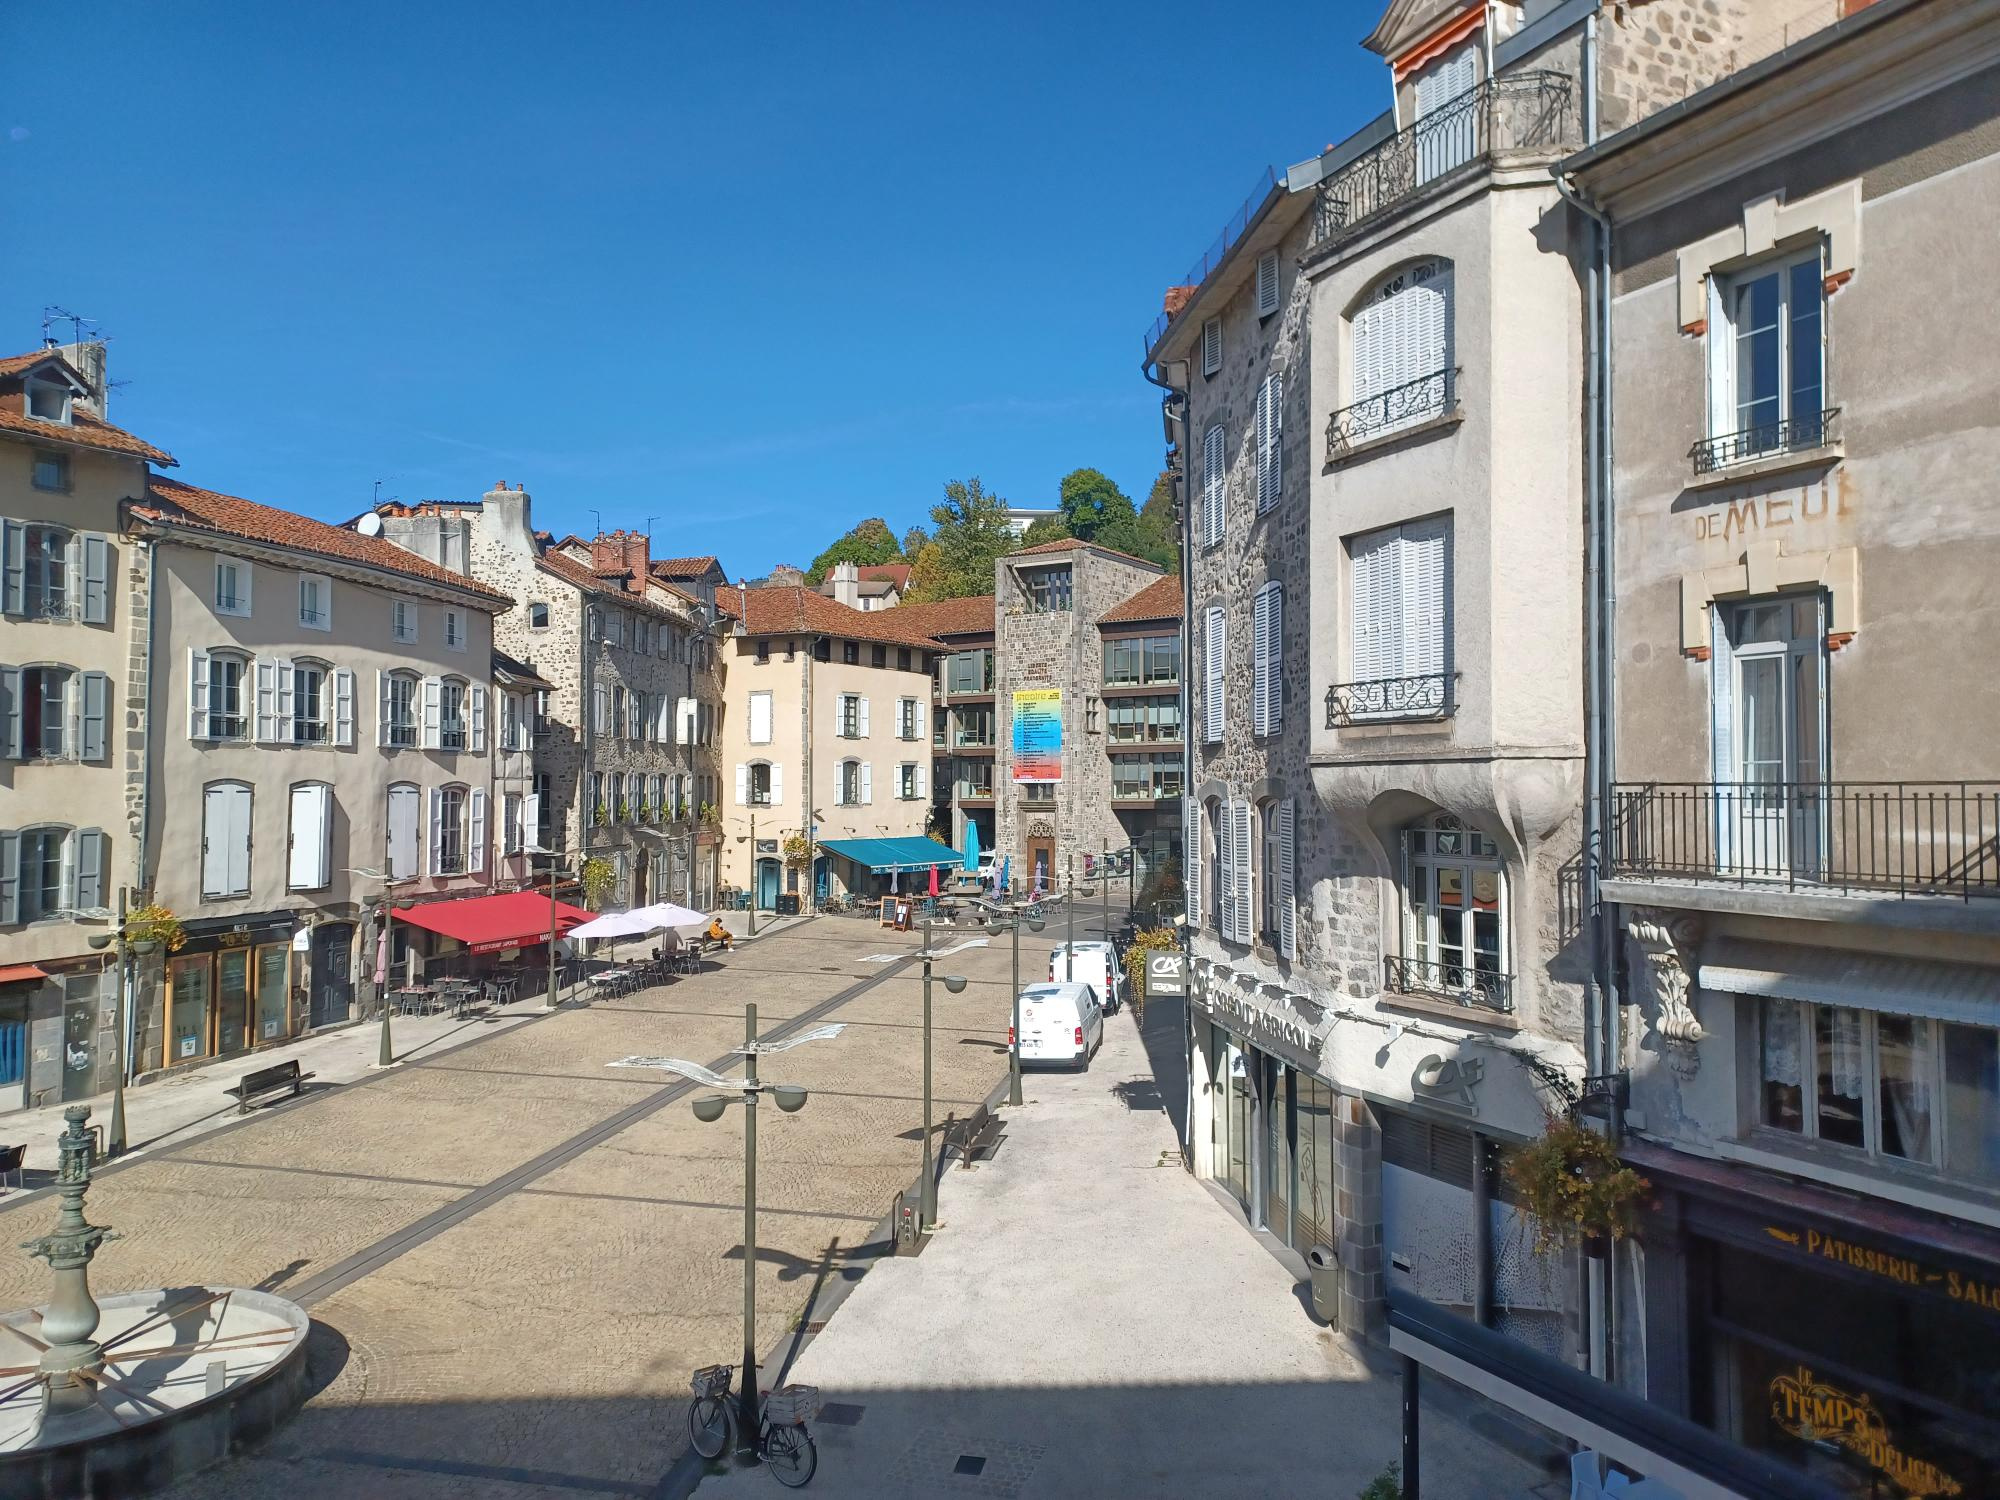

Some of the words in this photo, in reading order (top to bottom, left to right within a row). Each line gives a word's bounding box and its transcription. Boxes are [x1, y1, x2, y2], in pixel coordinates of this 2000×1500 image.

[1695, 513, 1721, 541] DE
[1152, 956, 1183, 974] CA
[1254, 1008, 1323, 1052] AGRICOLE
[1411, 1053, 1485, 1105] CA
[1798, 1365, 1812, 1385] LE
[1781, 1384, 1869, 1440] TEMPS
